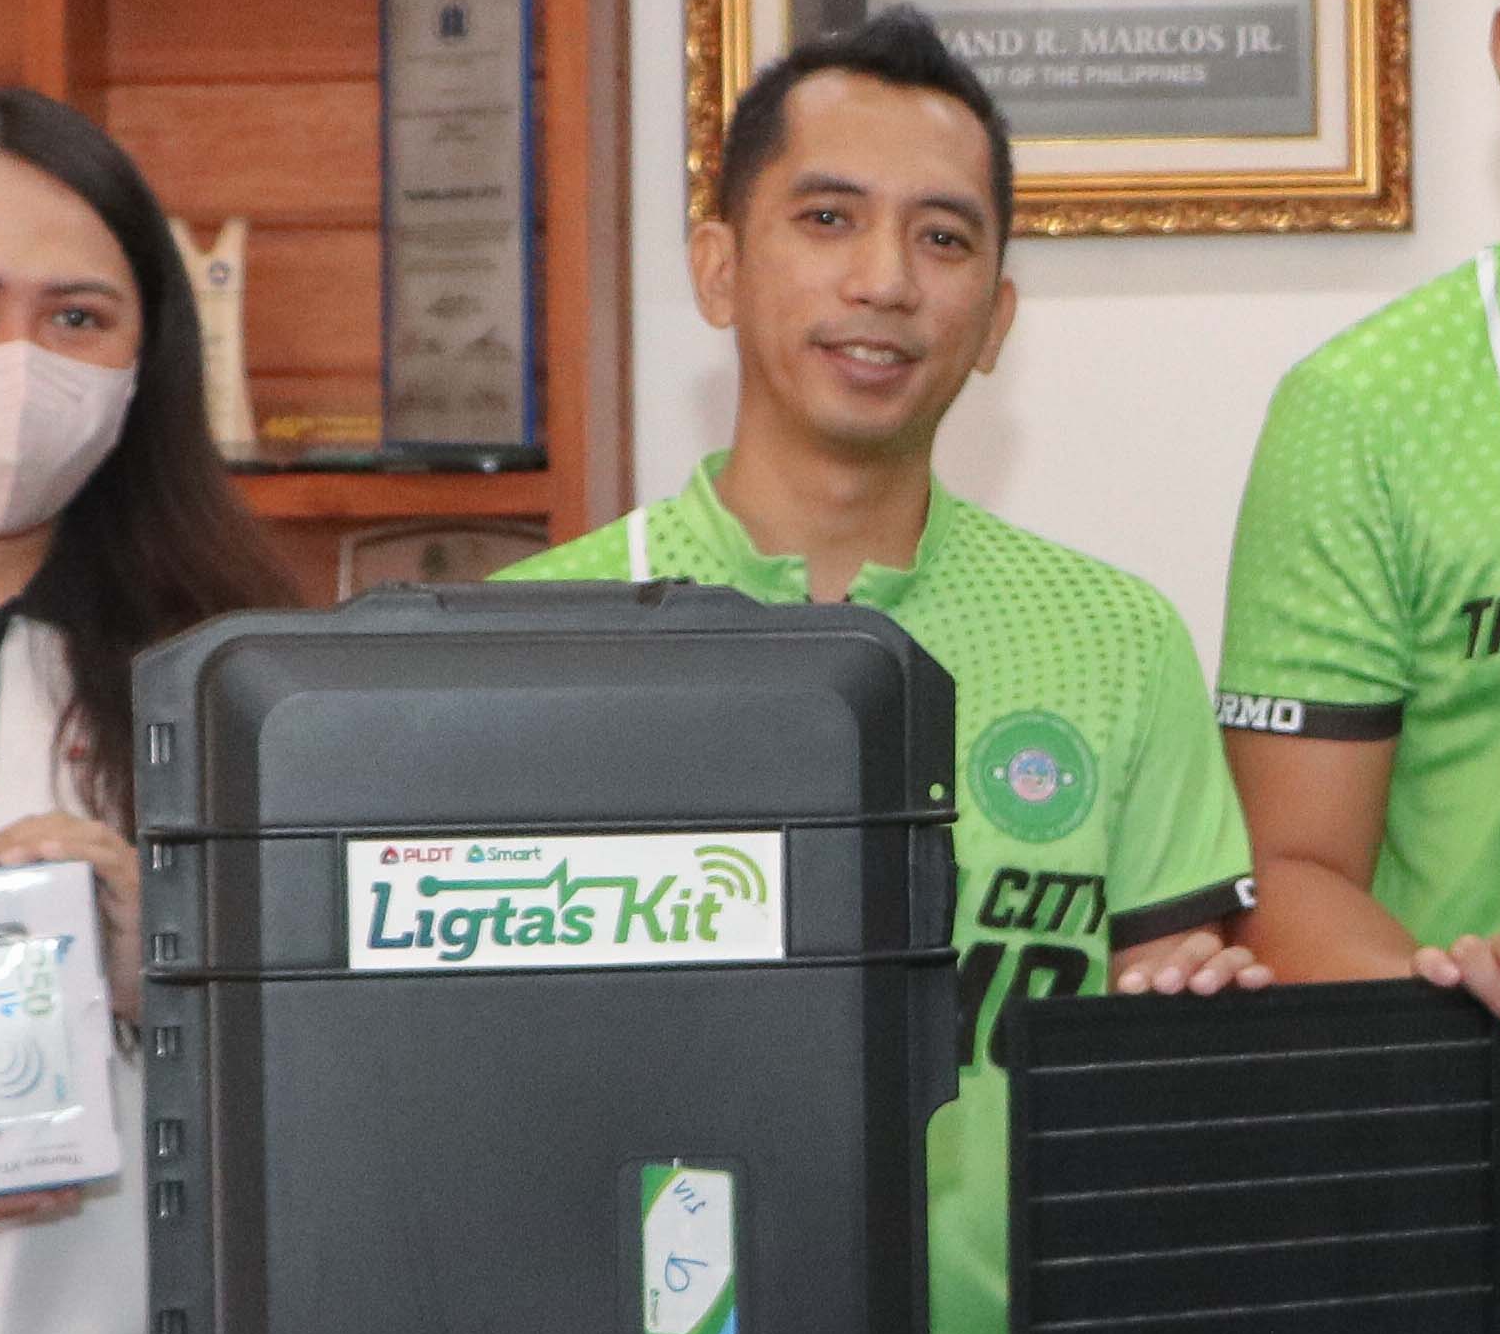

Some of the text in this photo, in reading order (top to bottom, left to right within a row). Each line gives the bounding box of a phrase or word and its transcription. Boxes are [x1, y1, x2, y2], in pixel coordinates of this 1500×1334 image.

[1035, 26, 1067, 56] R.
[1080, 24, 1225, 56] MARCOS
[1235, 23, 1283, 59] JR.
[1008, 65, 1037, 86] OF
[1041, 63, 1080, 85] THE
[1084, 62, 1207, 85] PHILIPPINES
[1216, 692, 1304, 735] RMO
[403, 844, 543, 864] PLDT Smart
[366, 873, 724, 963] Ligtas Kit
